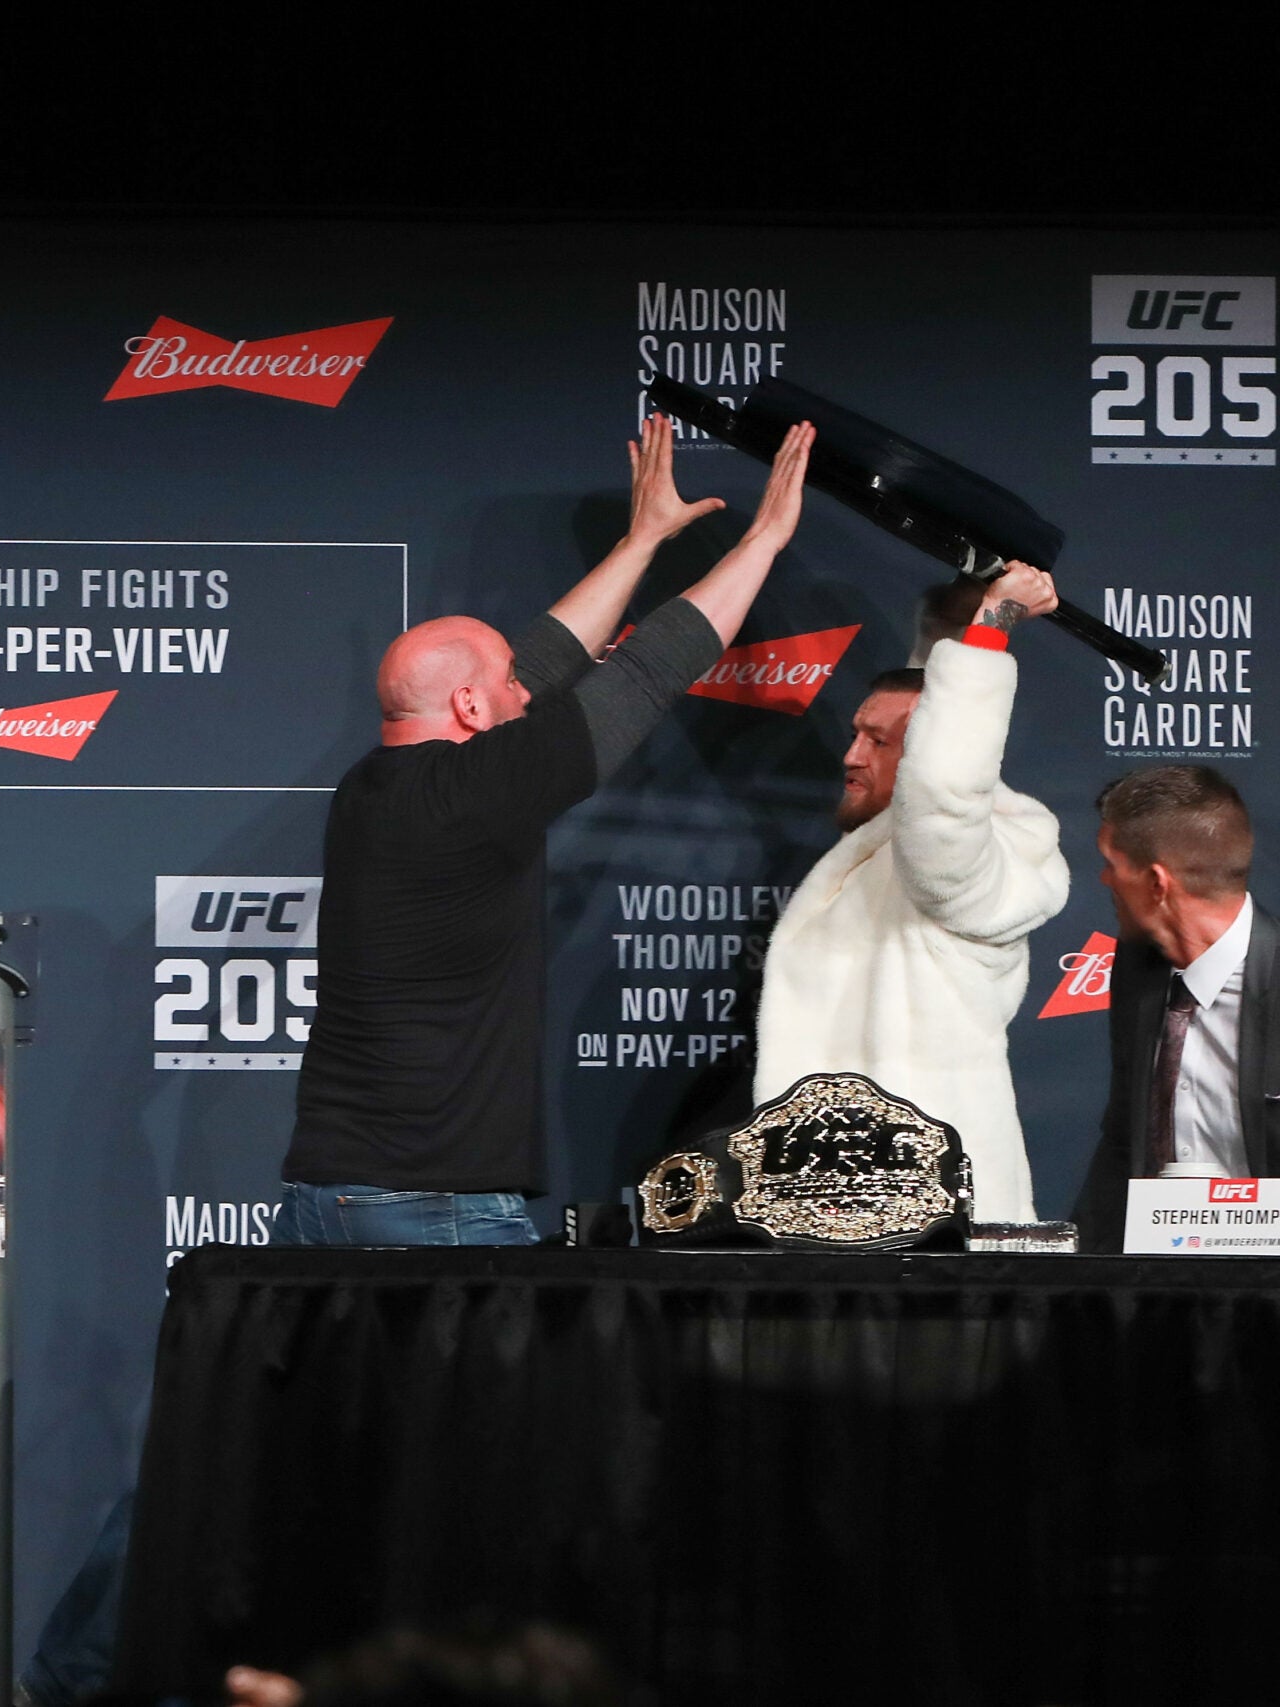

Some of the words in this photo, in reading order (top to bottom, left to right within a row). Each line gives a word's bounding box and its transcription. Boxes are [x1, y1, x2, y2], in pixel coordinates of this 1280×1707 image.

[638, 282, 786, 331] MADISON
[1126, 290, 1241, 330] UFC
[124, 336, 367, 379] Budweiser
[1091, 355, 1277, 438] 205
[81, 568, 230, 610] FIGHTS
[1104, 587, 1252, 639] MADISON
[694, 652, 833, 685] weiser
[1104, 696, 1252, 748] GARDEN
[191, 892, 306, 932] UFC
[612, 934, 766, 970] THOMPS
[621, 987, 689, 1022] NOV
[702, 988, 738, 1022] 12
[577, 1033, 608, 1059] ON
[1212, 1184, 1255, 1199] UFC
[166, 1196, 282, 1246] MADIS
[1152, 1210, 1220, 1225] STEPHEN
[1226, 1209, 1280, 1225] THOMP
